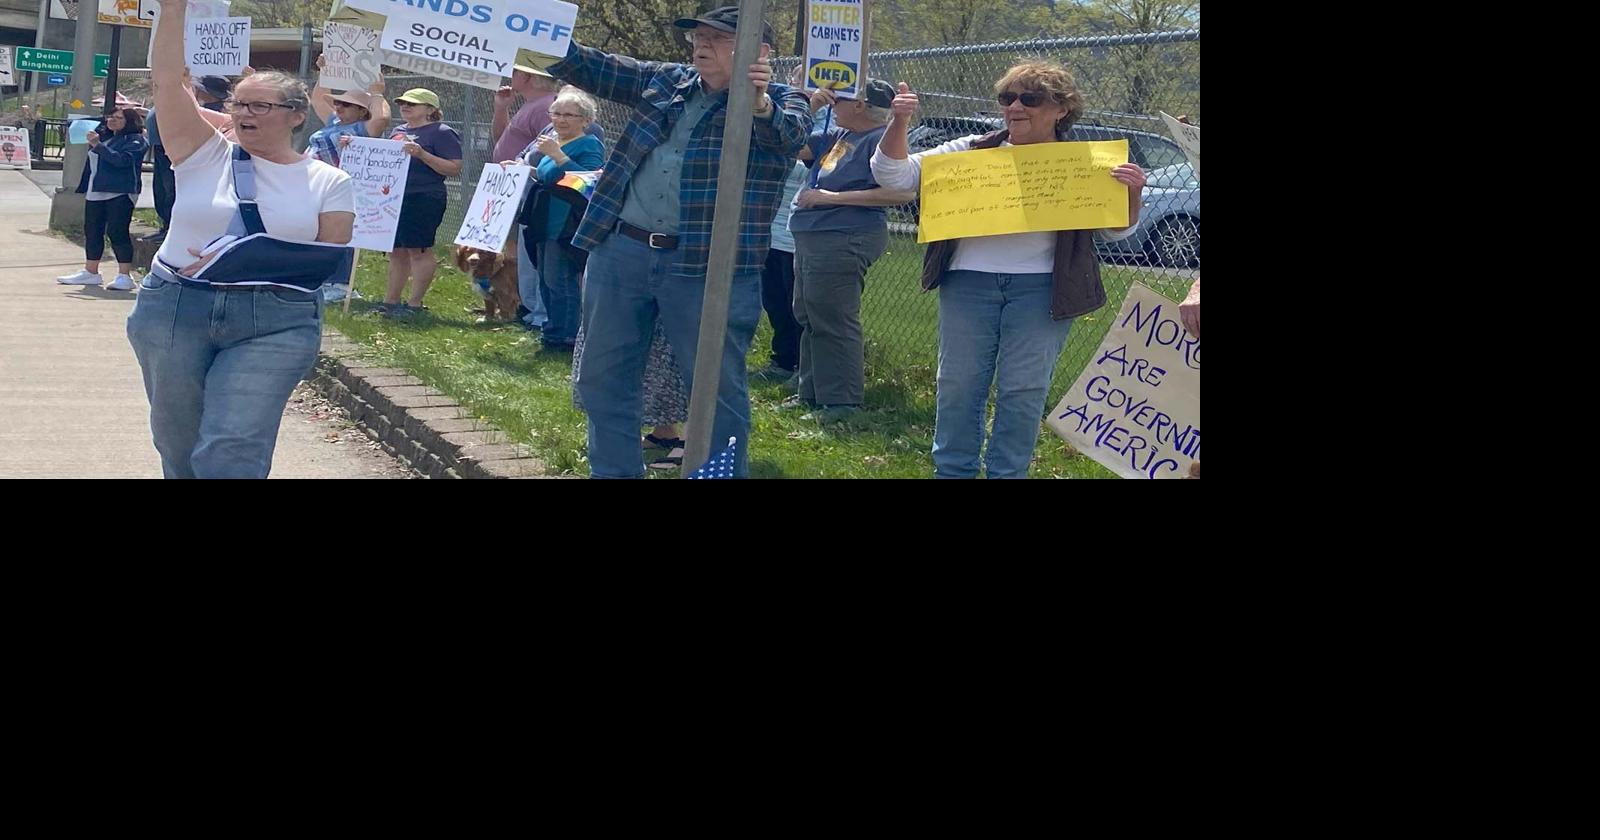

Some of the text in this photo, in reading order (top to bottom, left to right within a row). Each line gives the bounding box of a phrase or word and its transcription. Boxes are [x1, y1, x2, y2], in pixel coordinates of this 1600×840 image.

[388, 0, 571, 41] ANDS OFF
[812, 5, 860, 25] BETTER
[195, 22, 248, 36] HANDS OFF
[811, 26, 860, 42] CABINETS
[200, 36, 239, 50] SOCIAL
[410, 23, 494, 53] SOCIAL
[36, 52, 59, 60] Delhi
[393, 38, 508, 73] SECURITY
[829, 43, 840, 57] AT
[192, 51, 241, 66] SECURITY!
[815, 67, 851, 83] IKEA
[483, 172, 520, 197] HANDS
[1097, 344, 1167, 387] ARE
